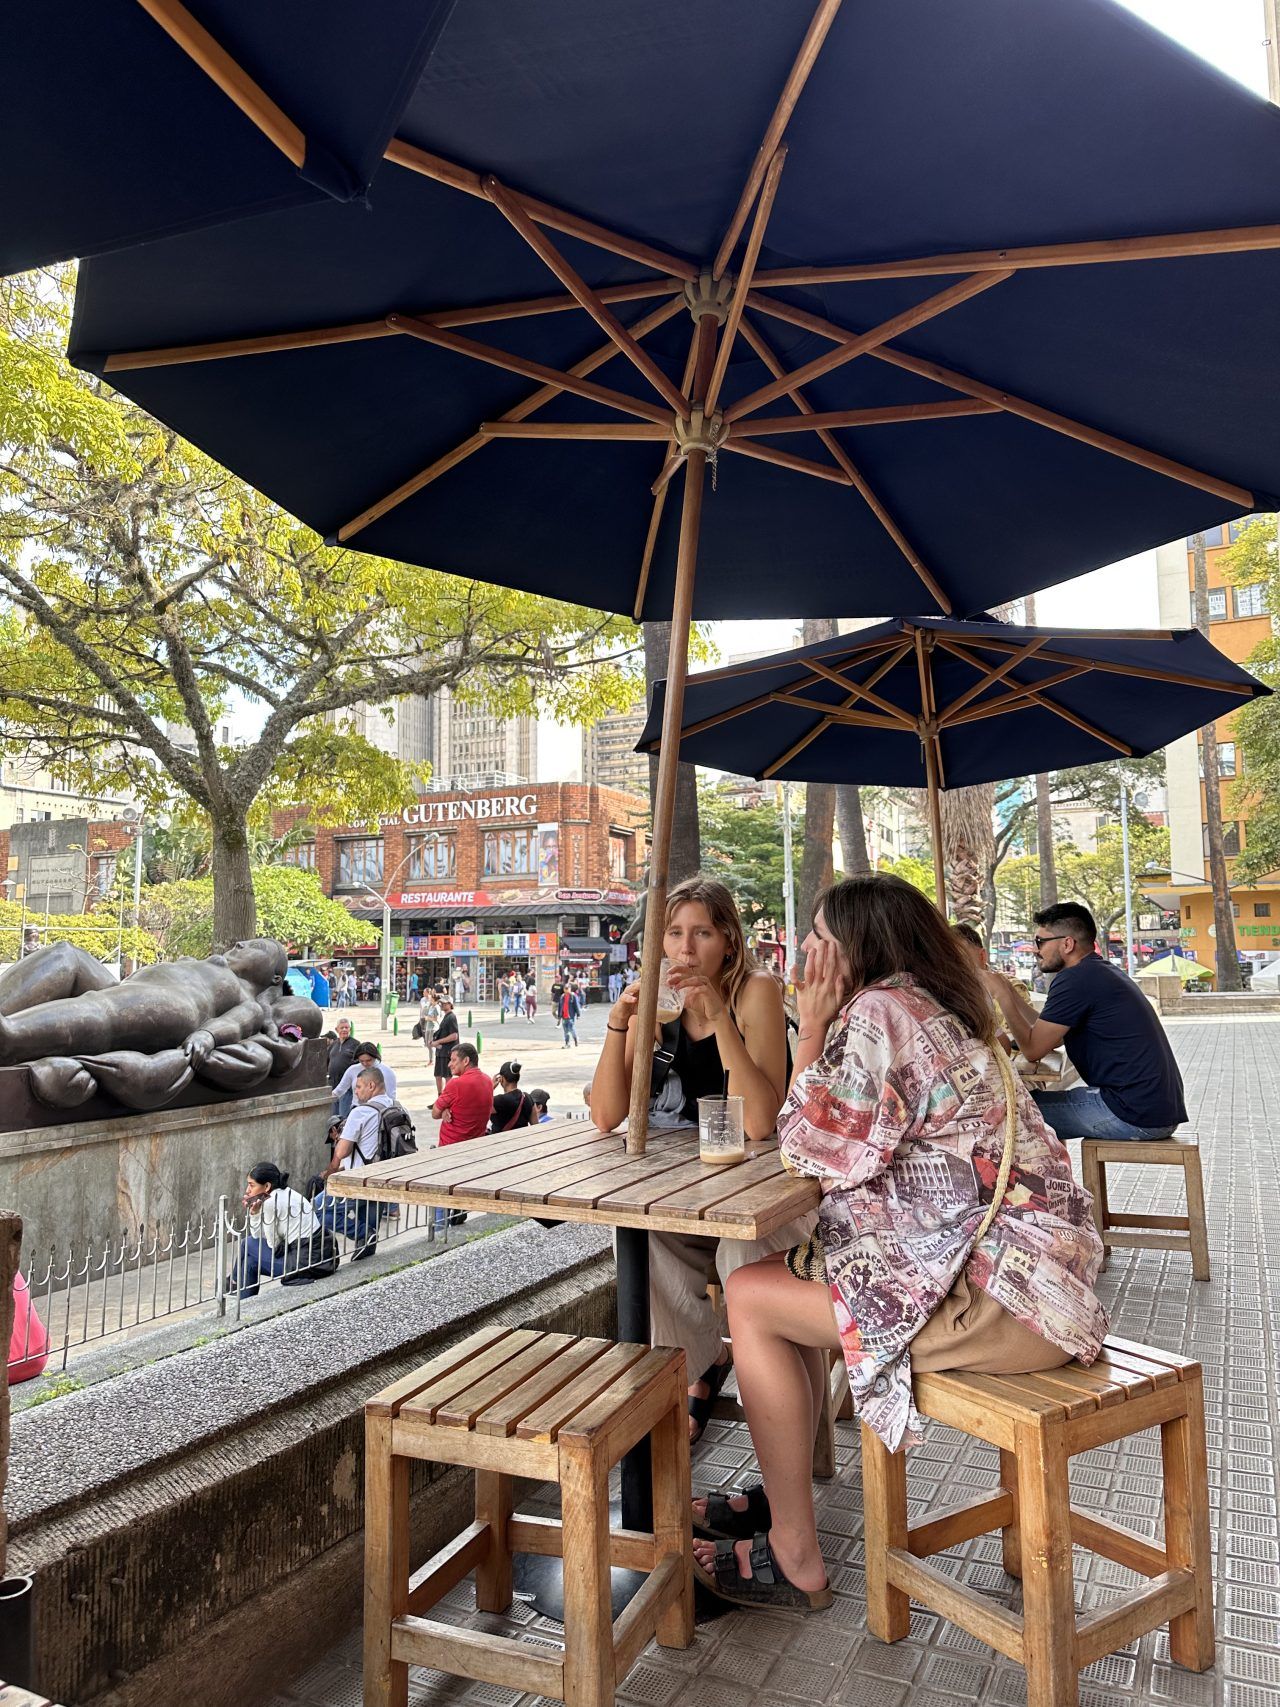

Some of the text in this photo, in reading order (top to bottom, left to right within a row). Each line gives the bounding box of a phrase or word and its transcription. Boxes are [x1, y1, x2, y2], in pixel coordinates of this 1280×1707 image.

[403, 794, 537, 824] GUTENBERG
[401, 892, 475, 904] RESTAURANTE
[1046, 1180, 1071, 1193] JONES
